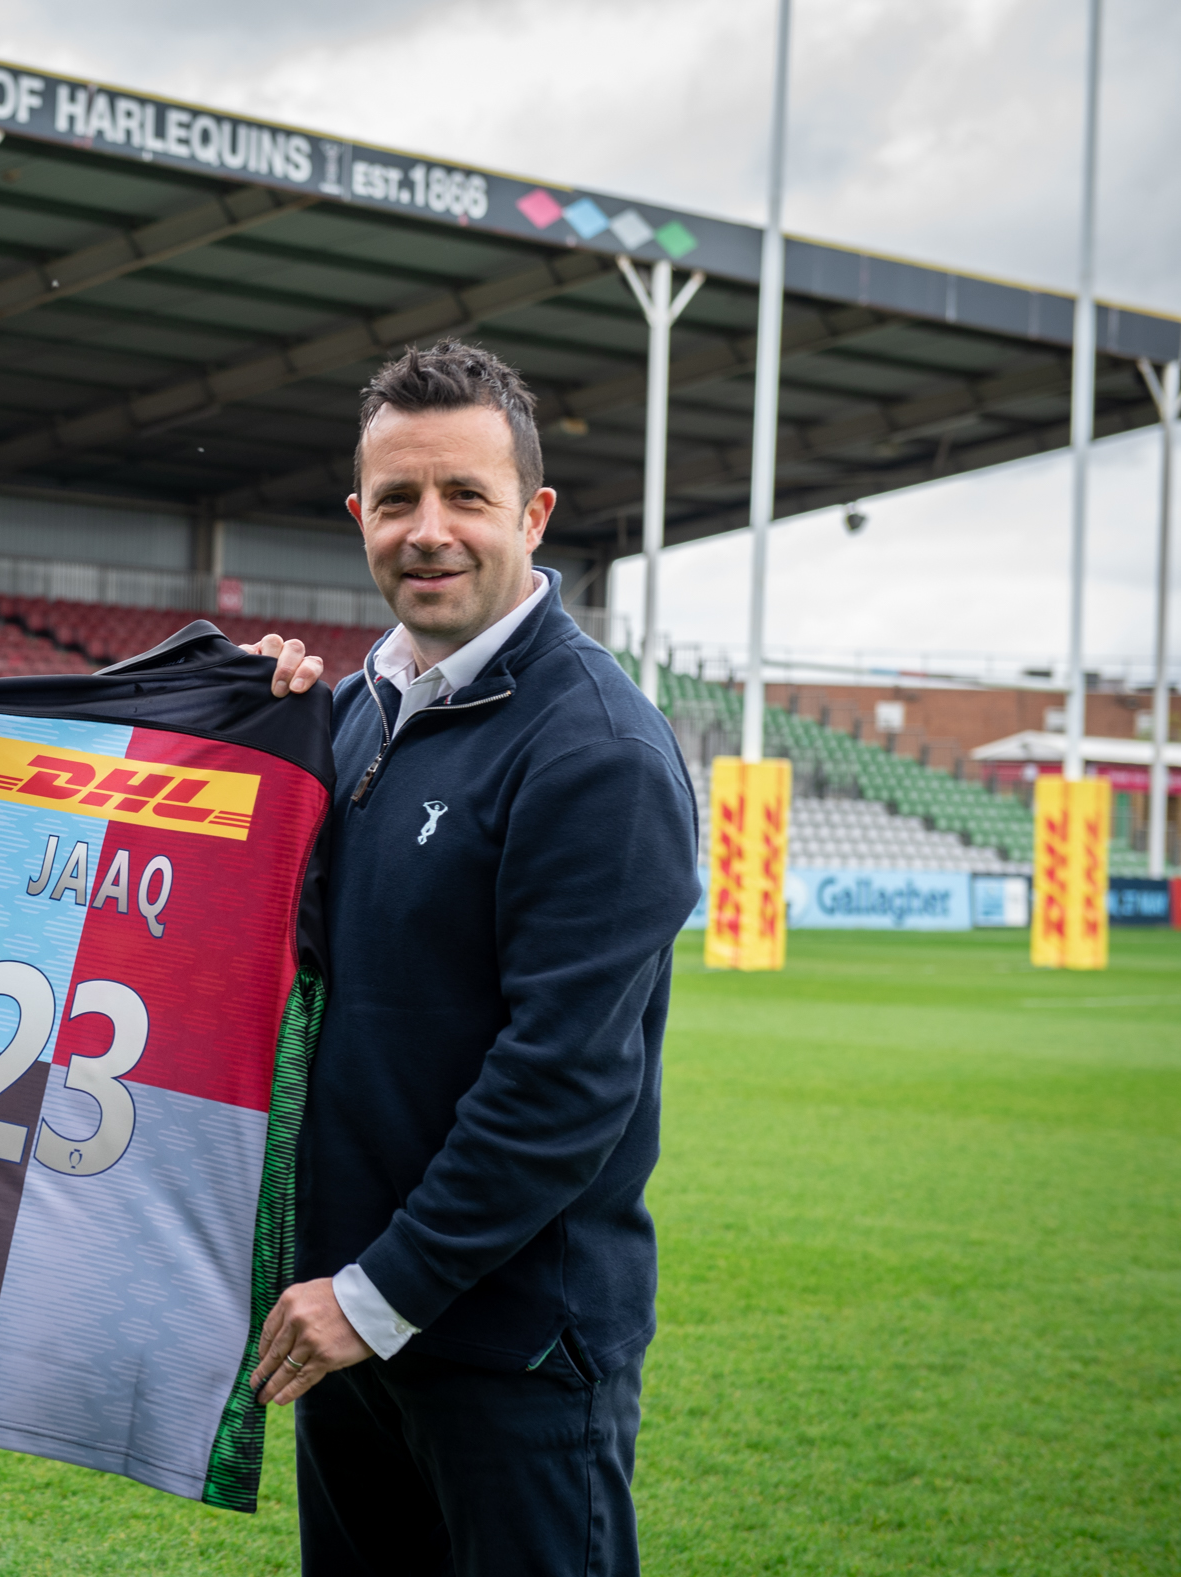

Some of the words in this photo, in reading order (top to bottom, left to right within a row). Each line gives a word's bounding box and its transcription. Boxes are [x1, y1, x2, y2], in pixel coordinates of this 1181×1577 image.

[55, 86, 313, 182] HARLEQUINS
[15, 754, 216, 823] DHL
[26, 834, 173, 938] JAAQ
[817, 876, 953, 927] Gallagher
